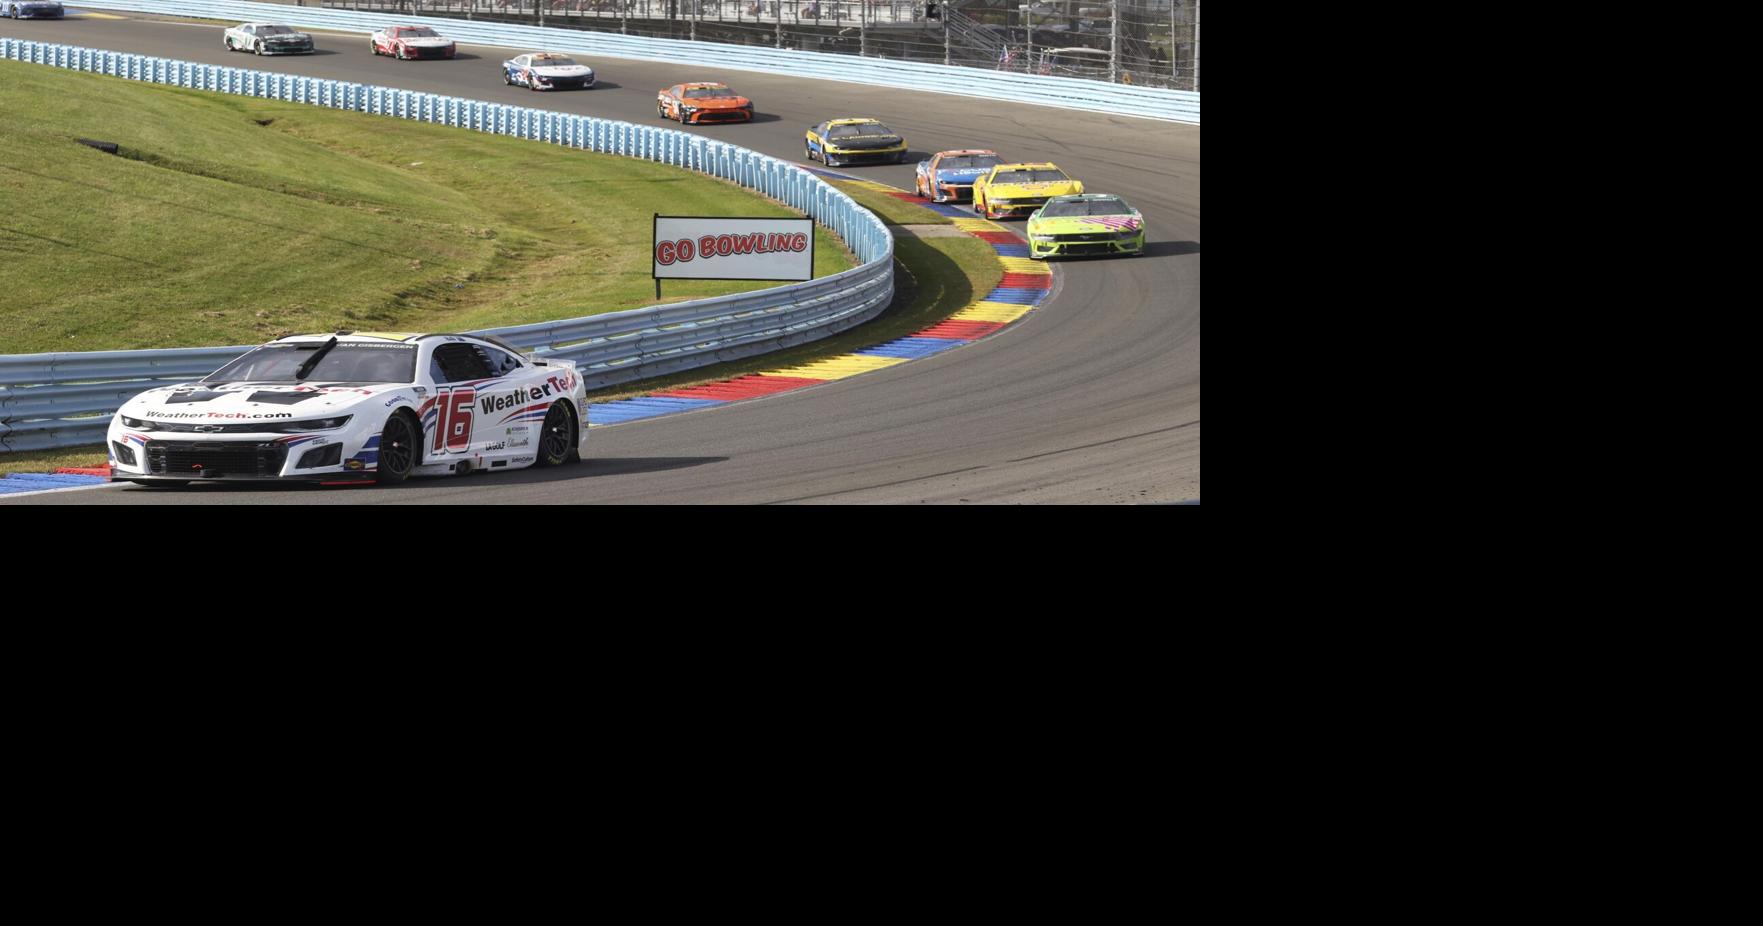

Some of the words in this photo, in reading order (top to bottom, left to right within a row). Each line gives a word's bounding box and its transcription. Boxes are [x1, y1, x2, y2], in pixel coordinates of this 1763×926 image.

[656, 239, 696, 266] GO
[698, 232, 808, 259] BOWLING
[481, 368, 578, 415] WeatherTech
[145, 410, 293, 419] WeatherTech.com
[431, 386, 477, 455] 16
